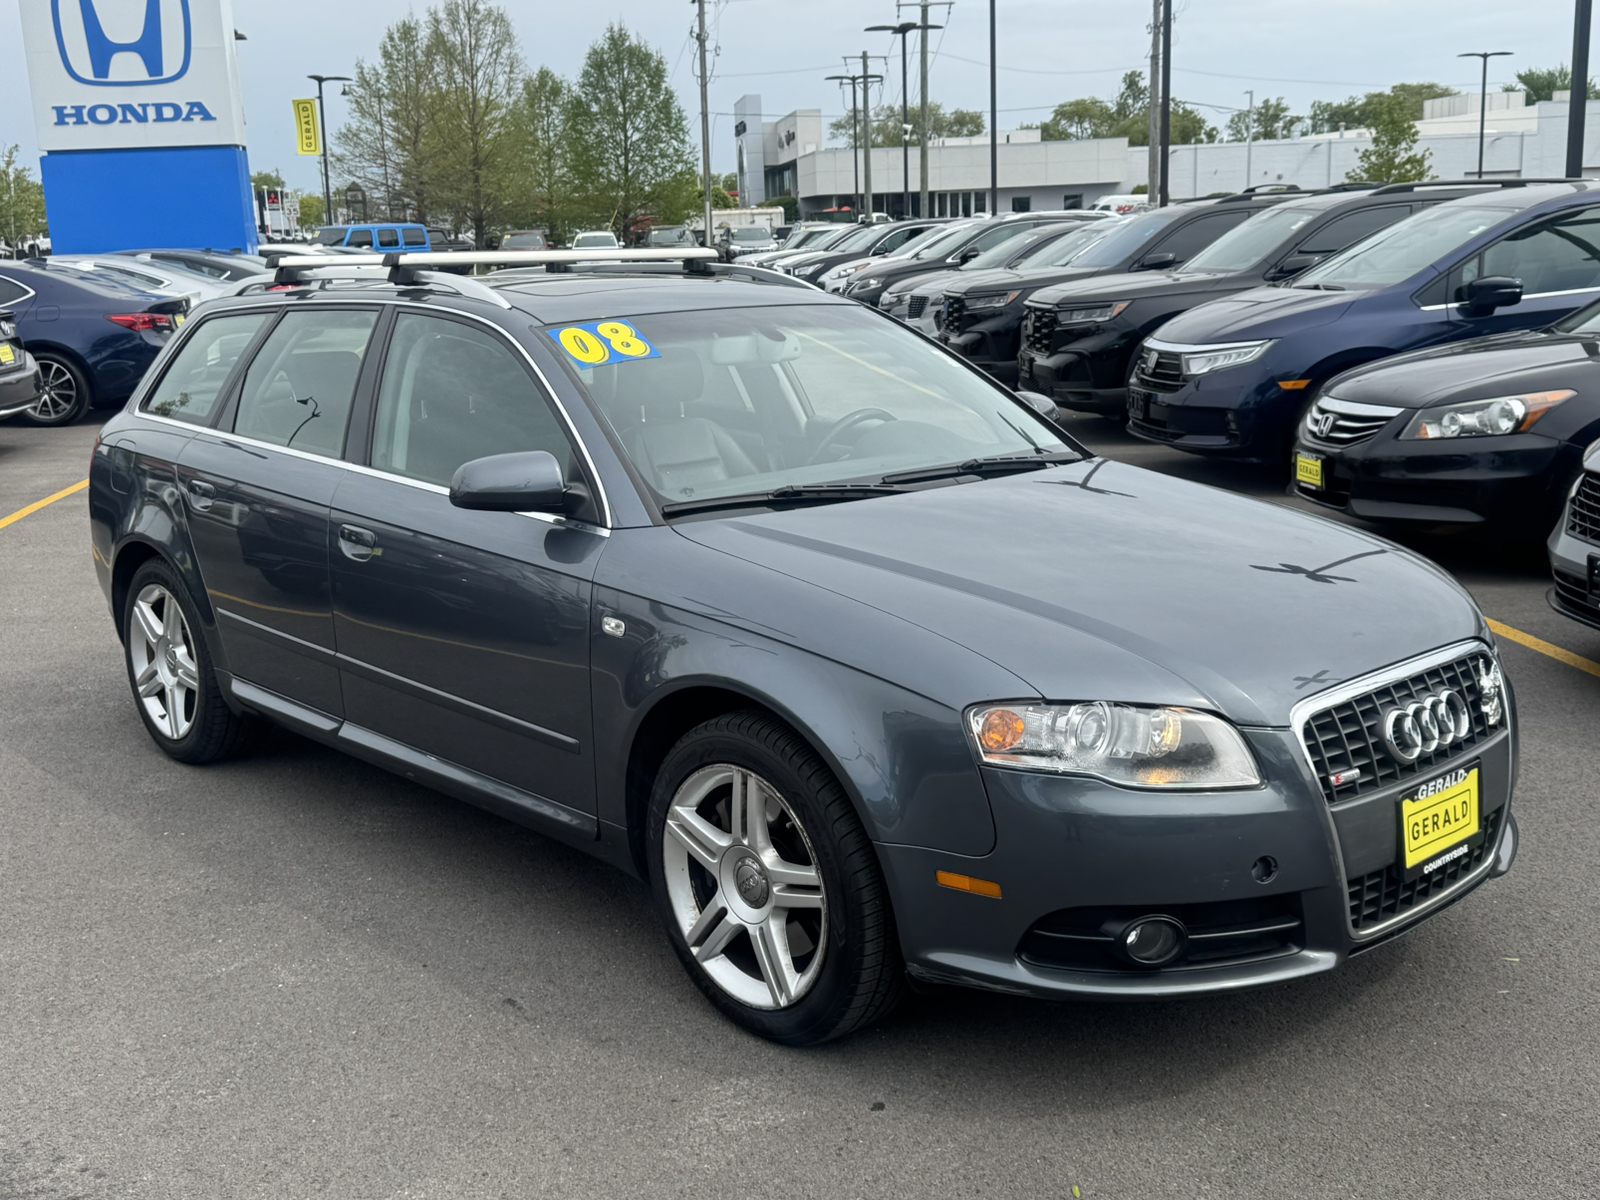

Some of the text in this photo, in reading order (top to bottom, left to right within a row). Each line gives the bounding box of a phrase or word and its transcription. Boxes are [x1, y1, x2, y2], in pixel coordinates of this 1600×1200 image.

[52, 101, 217, 126] HONDA
[301, 105, 313, 148] GERALD
[287, 208, 299, 216] 35
[558, 321, 651, 365] 08
[1299, 464, 1319, 478] GERALD
[1417, 768, 1466, 800] GERALD
[1411, 800, 1468, 841] GERALD
[1423, 844, 1469, 874] COUNTRYSIDE
